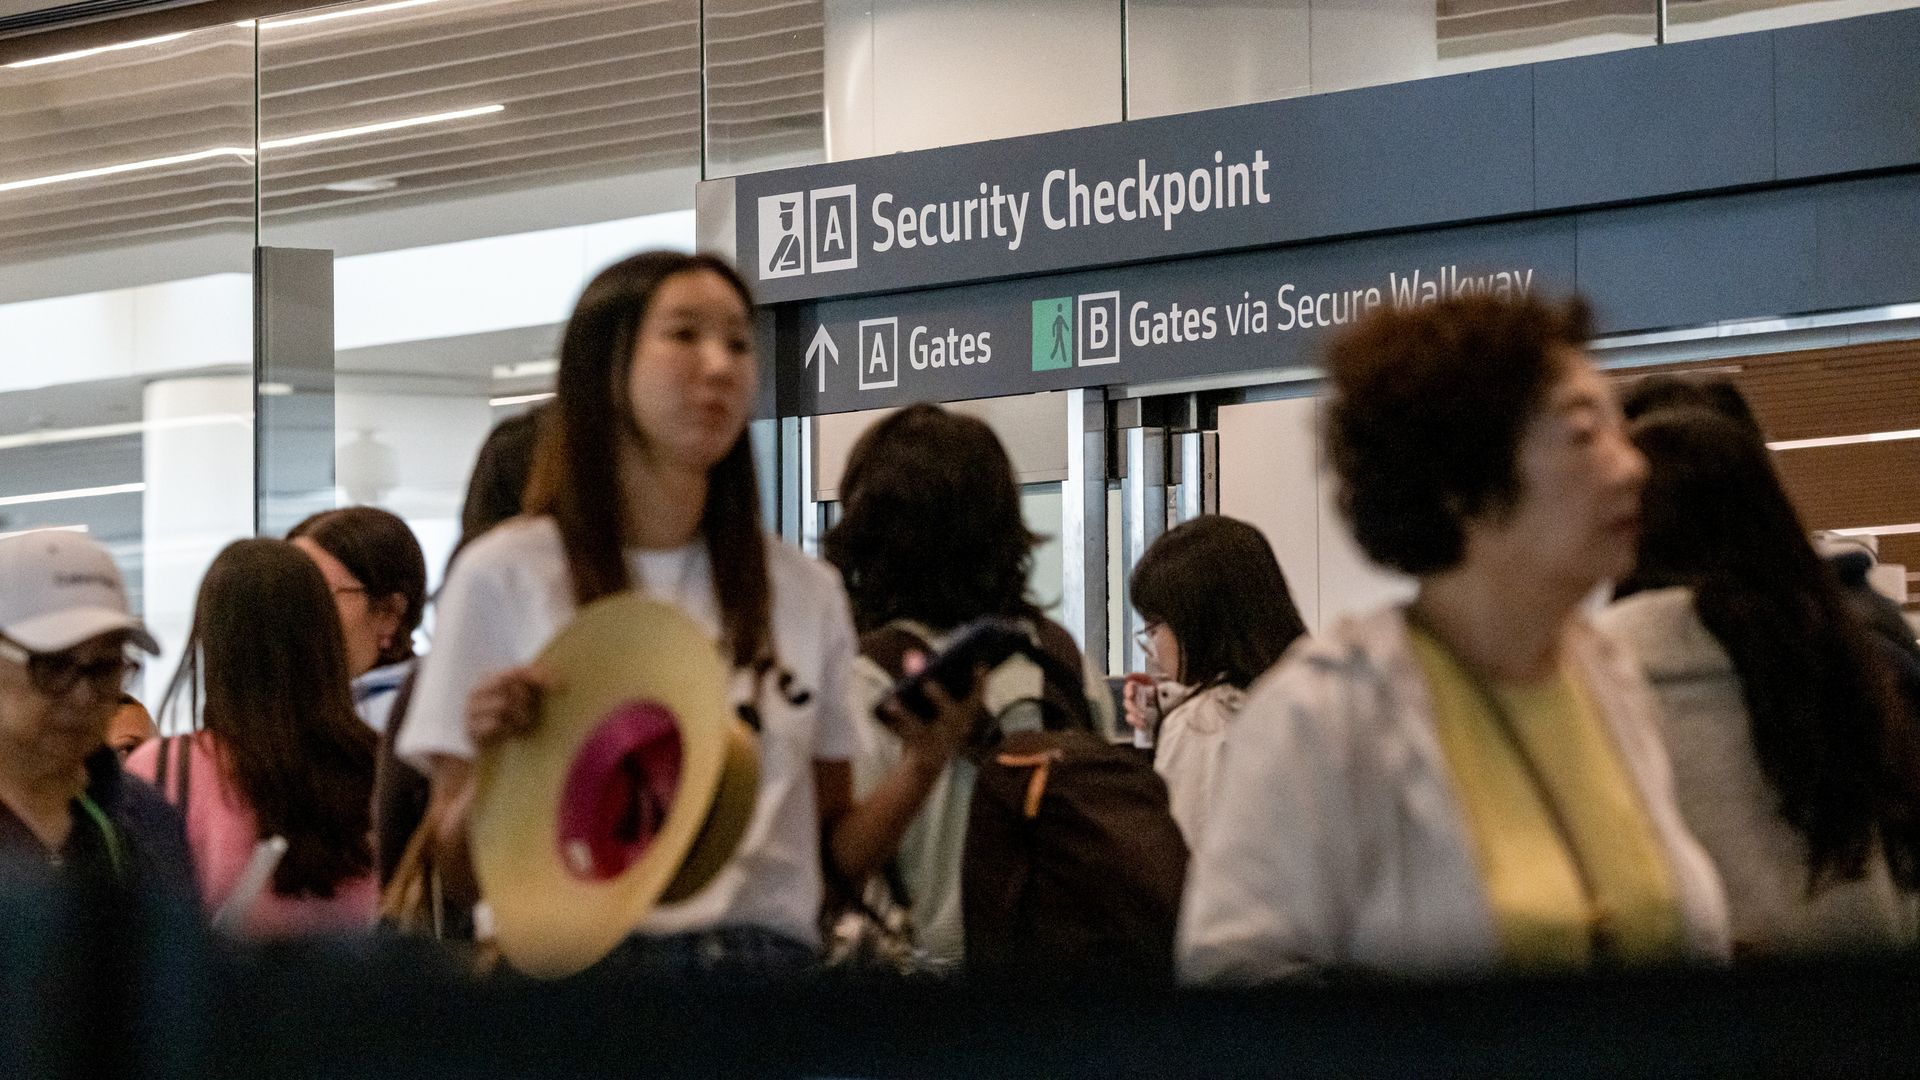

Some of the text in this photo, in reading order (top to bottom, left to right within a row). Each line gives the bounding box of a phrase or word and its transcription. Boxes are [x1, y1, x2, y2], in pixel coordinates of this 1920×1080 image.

[823, 149, 1271, 253] A Security Checkpoint
[868, 325, 992, 375] A Gates
[1090, 306, 1109, 350] B
[1129, 300, 1218, 347] Gates
[1225, 291, 1269, 336] via
[1277, 283, 1382, 331] Secure
